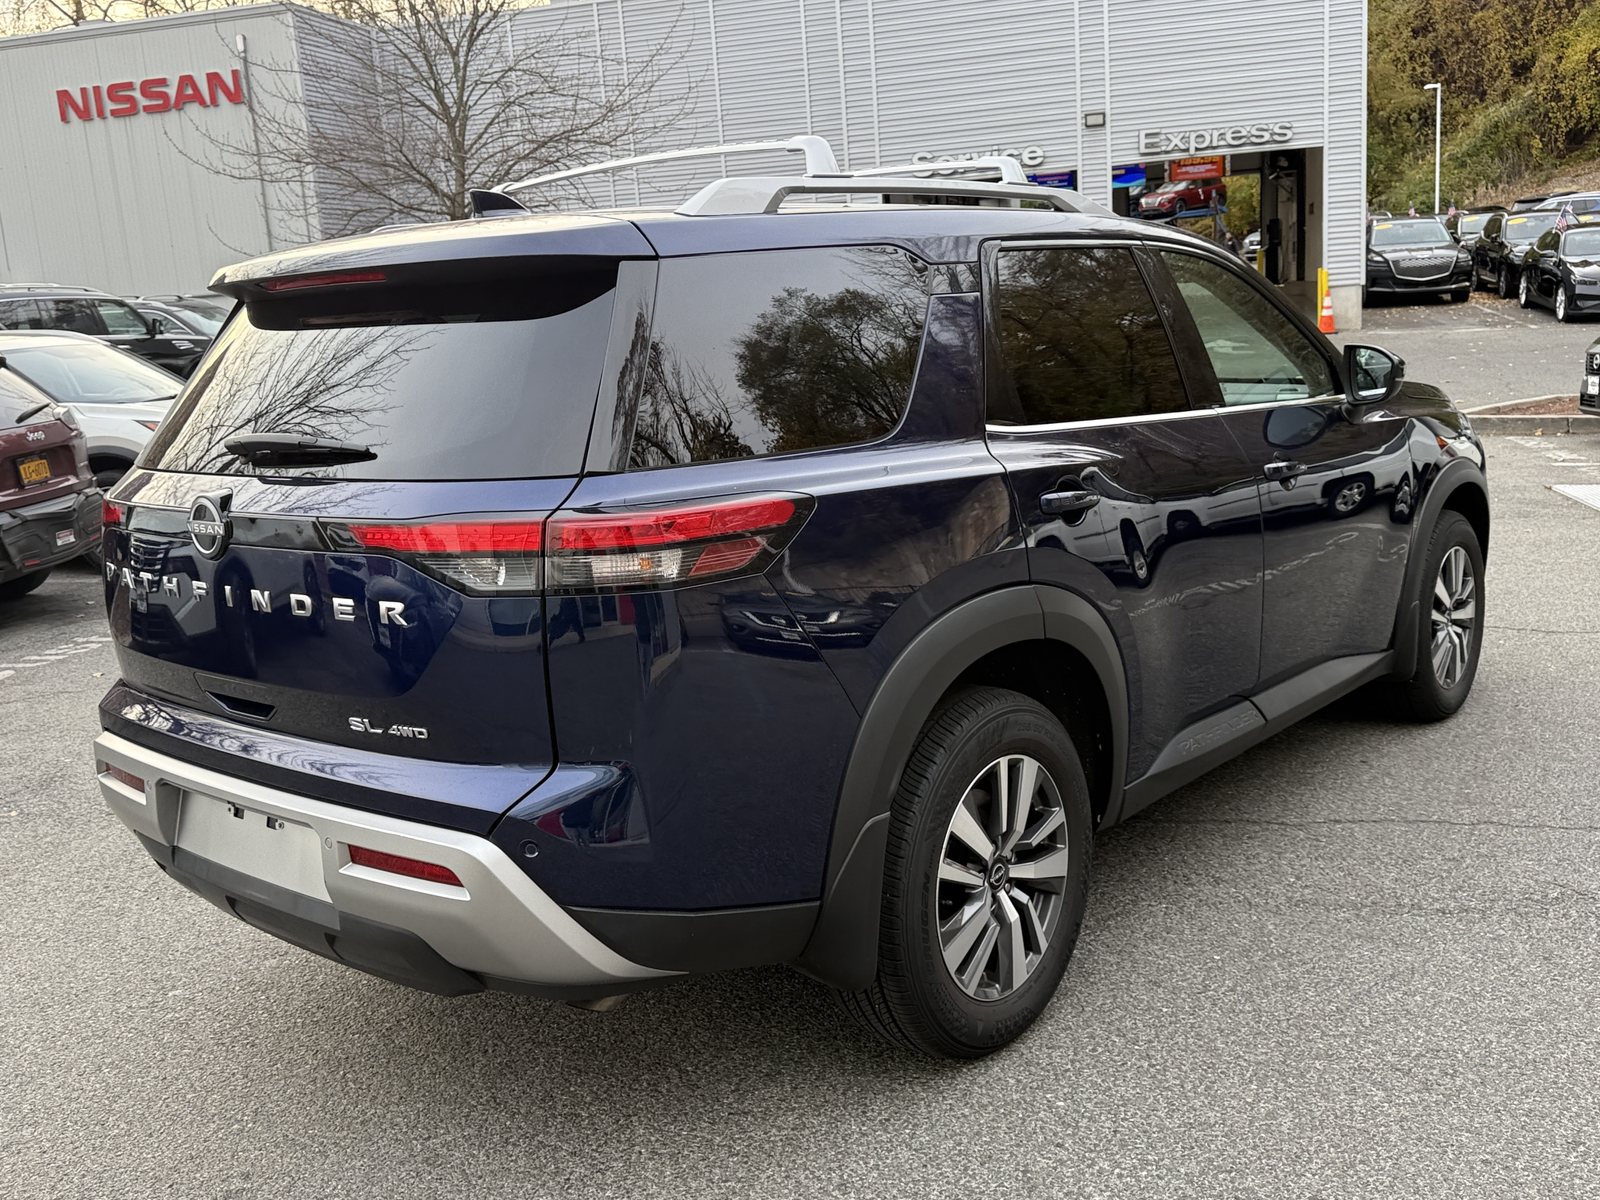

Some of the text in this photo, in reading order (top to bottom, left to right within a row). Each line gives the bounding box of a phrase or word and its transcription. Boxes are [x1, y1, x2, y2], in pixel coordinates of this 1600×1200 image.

[56, 69, 244, 123] NISSAN
[1139, 121, 1294, 155] Express
[26, 431, 45, 441] Jeep
[106, 561, 408, 627] PATHFINDER
[348, 716, 428, 739] SL 4WD
